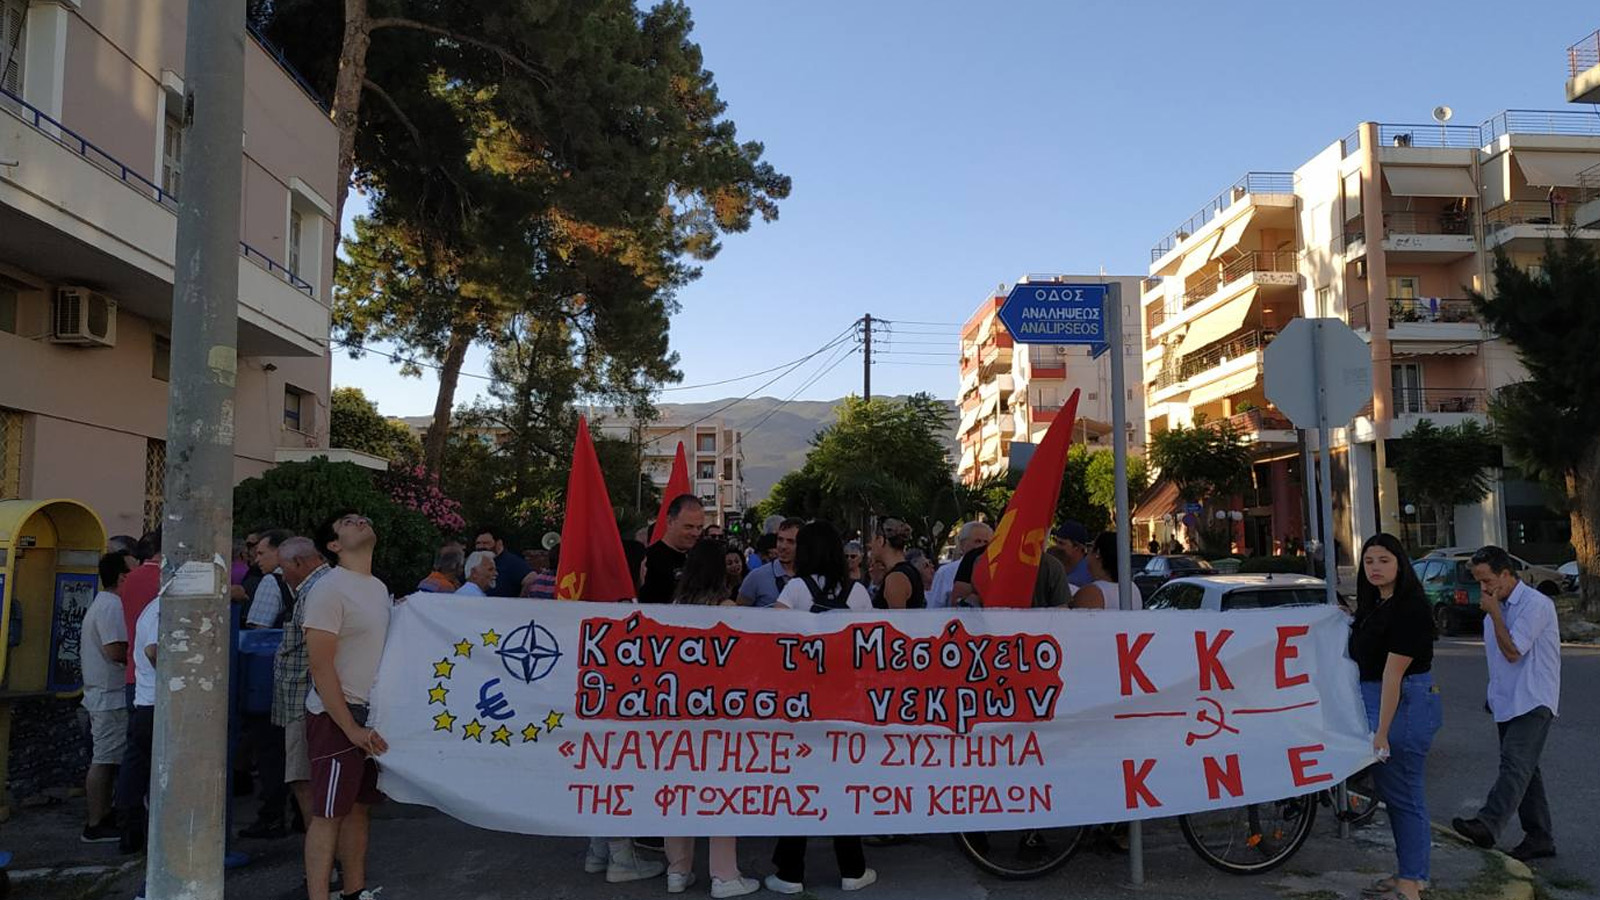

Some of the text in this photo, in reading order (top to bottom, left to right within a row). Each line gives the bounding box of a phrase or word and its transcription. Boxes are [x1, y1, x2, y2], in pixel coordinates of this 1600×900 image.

[1021, 307, 1100, 320] ΑΝΑΛΗΨΕΩΣ
[1035, 289, 1084, 302] ΟΔΟΣ
[1020, 322, 1099, 334] ANALIPSEOS
[581, 617, 1059, 682] Κάναν τη Μεσόγειο
[580, 670, 1058, 734] θάλασσα νεκρών
[558, 729, 1045, 774] «ΝΑΥΑΓΗΣΕ» ΤΟ ΣΥΣΤΗΜΑ
[568, 784, 1052, 821] ΤΗΣ ΦΤΩΧΕΙΑΣ, ΤΩΝ ΚΕΡΔΩΝ
